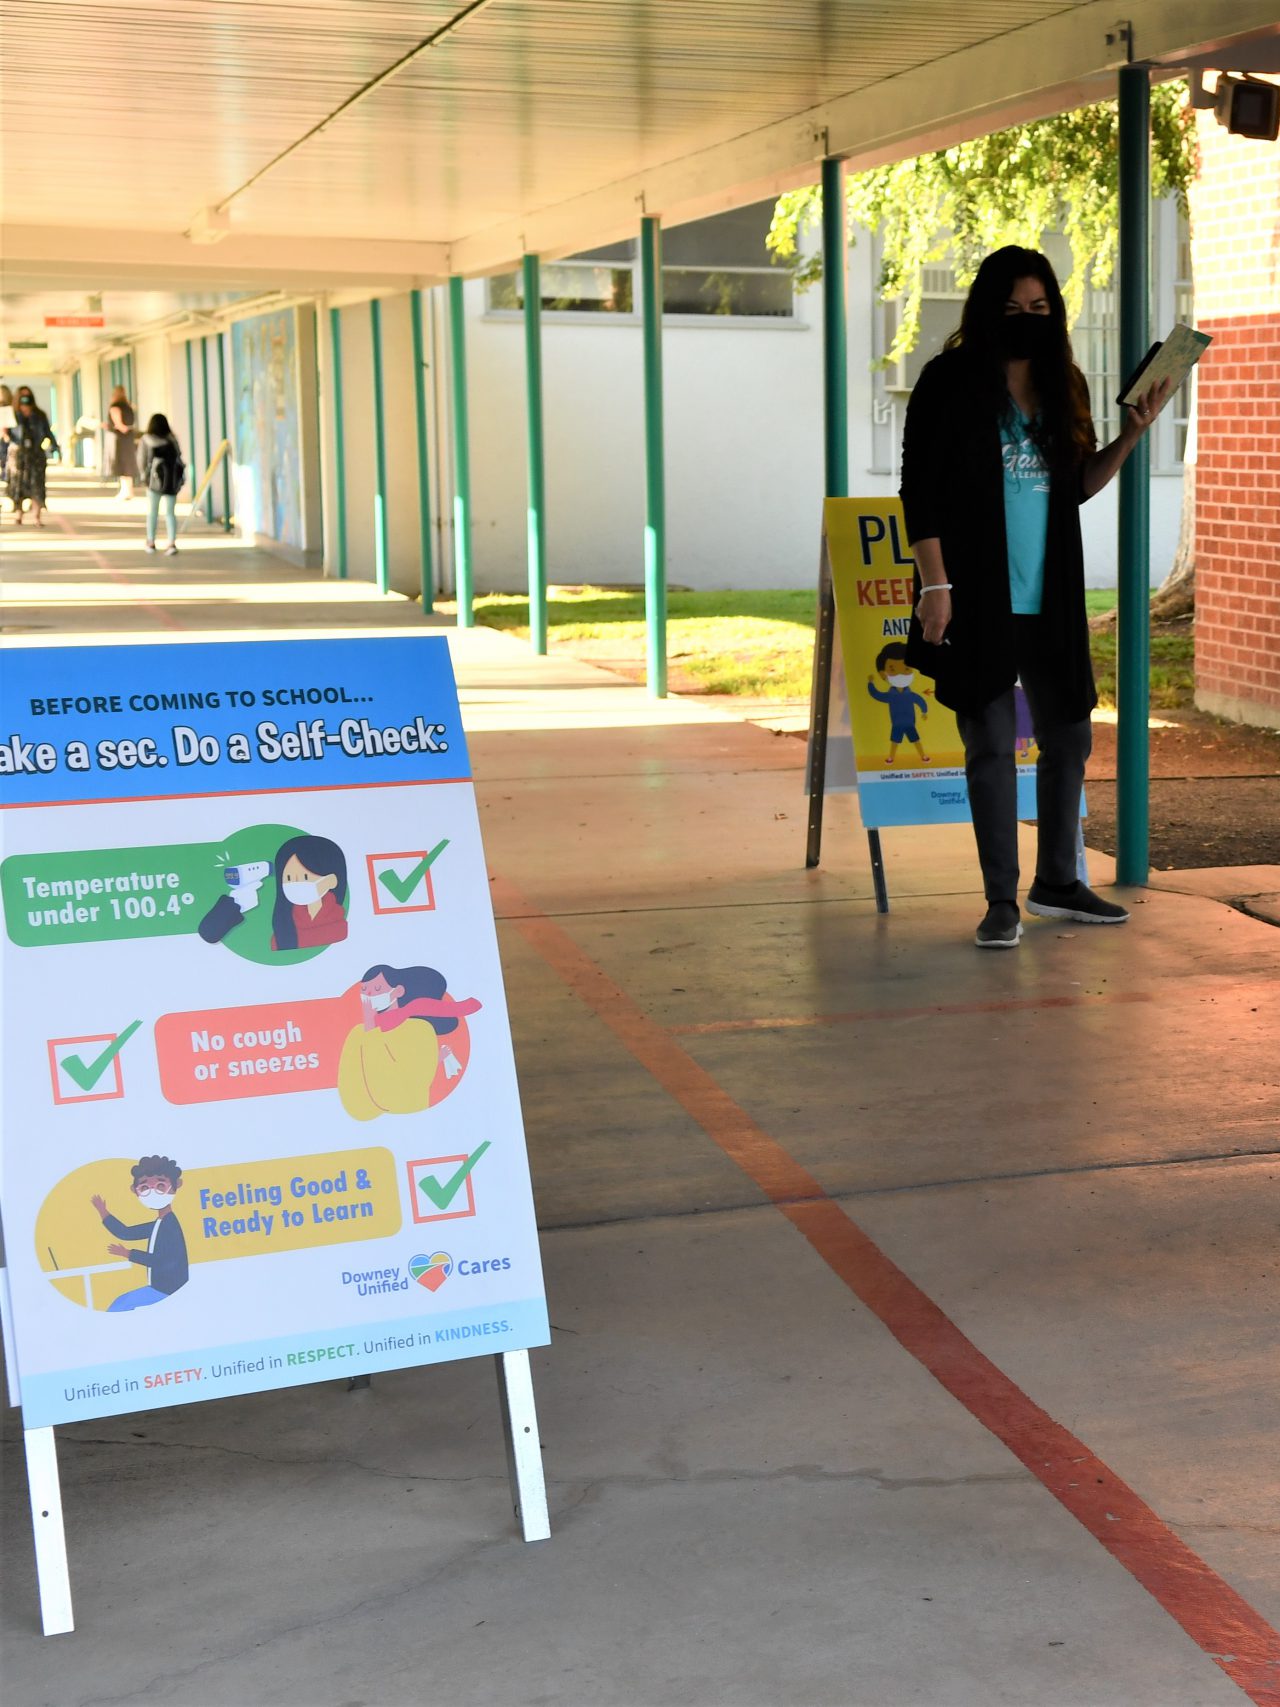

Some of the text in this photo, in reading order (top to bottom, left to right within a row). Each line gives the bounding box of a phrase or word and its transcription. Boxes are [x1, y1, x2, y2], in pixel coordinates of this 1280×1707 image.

[883, 618, 911, 636] AND
[30, 687, 373, 716] BEFORE COMING TO SCHOOL...
[66, 740, 91, 772] a
[97, 737, 168, 769] sec.
[172, 725, 220, 766] Do
[227, 733, 251, 763] a
[256, 716, 448, 763] Self-Check:
[23, 872, 180, 900] Temperature
[28, 901, 100, 927] under
[191, 1020, 302, 1053] No cough
[194, 1053, 319, 1081] or sneezes
[200, 1168, 372, 1209] Feeling Good &
[203, 1201, 373, 1238] Ready to Learn
[342, 1257, 511, 1285] Downey Cares
[357, 1277, 409, 1297] Unified
[64, 1320, 513, 1402] Unified in SAFETY. Unified in RESPECT. Unified in KINDNESS.
